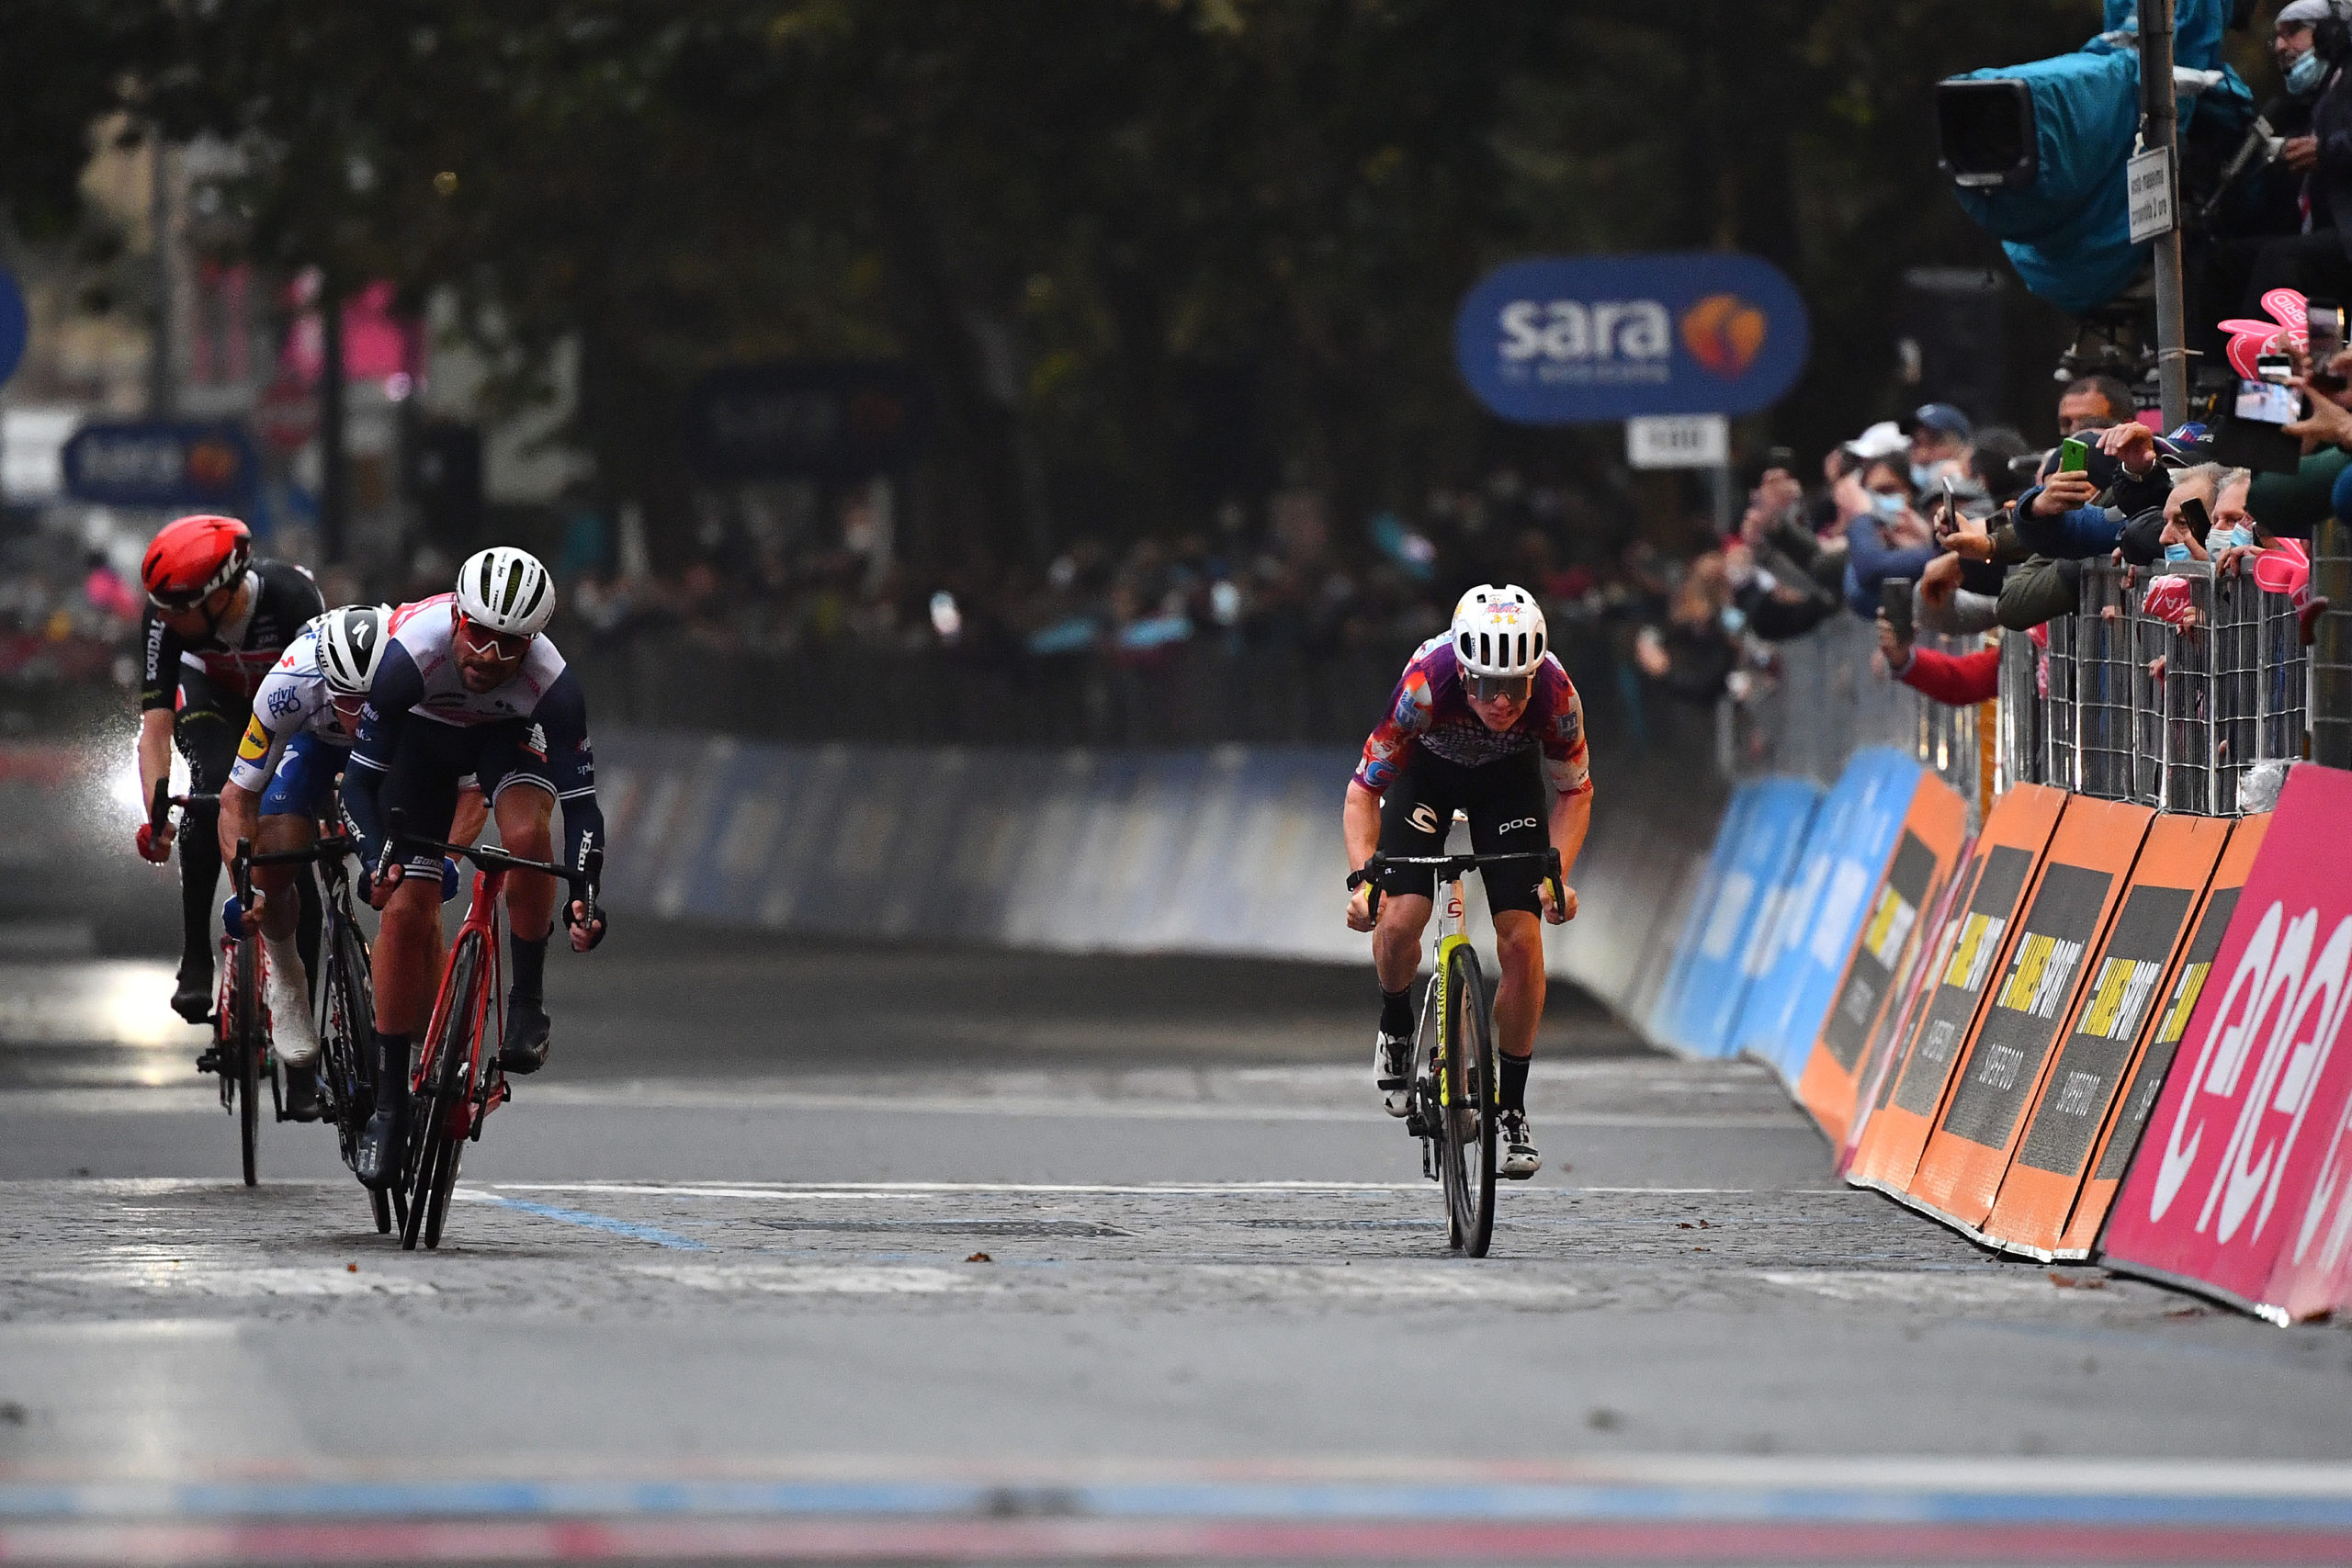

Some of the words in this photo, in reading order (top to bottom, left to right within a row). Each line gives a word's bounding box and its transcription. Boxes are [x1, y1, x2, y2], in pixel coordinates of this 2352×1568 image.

[1500, 299, 1670, 359] sara
[146, 618, 165, 681] SOUDAL
[267, 685, 298, 705] crivit
[268, 697, 301, 719] PRO
[577, 829, 594, 872] TREK
